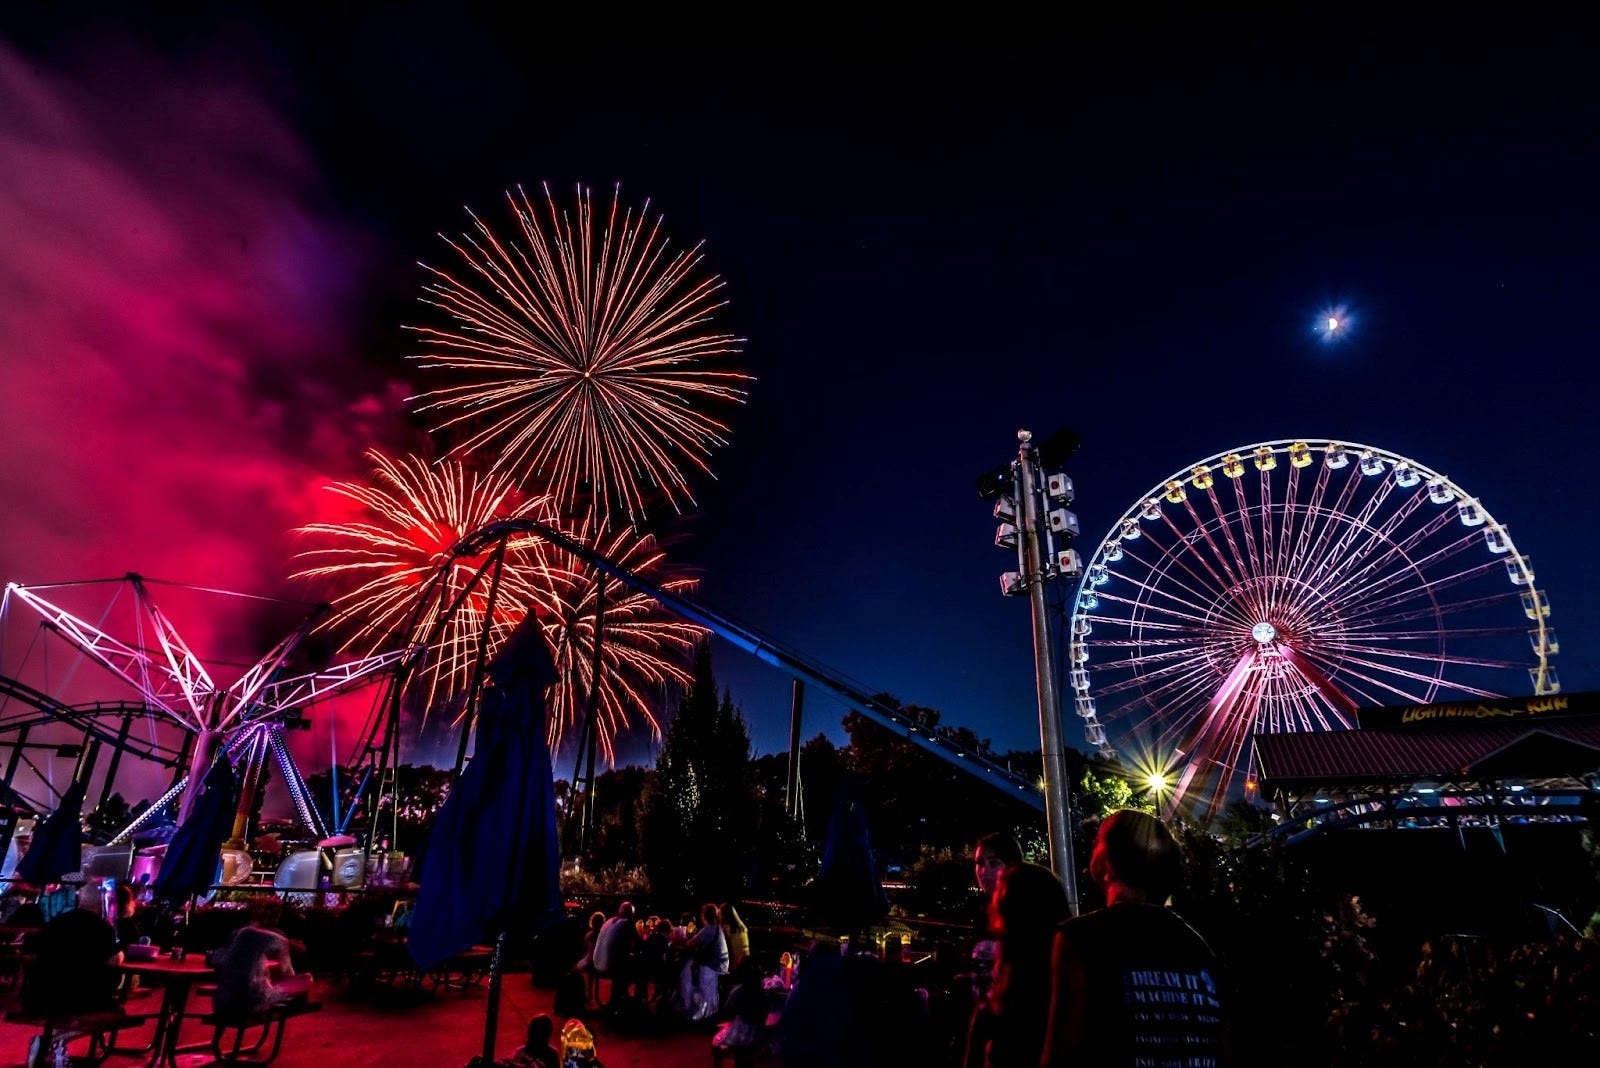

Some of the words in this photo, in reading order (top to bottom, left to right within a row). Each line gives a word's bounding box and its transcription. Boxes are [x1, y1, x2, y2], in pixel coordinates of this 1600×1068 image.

[1402, 704, 1490, 723] LIGHTNING
[1526, 697, 1569, 714] RUN
[1131, 970, 1181, 988] DREAM
[1185, 974, 1199, 990] IT
[1134, 991, 1188, 1004] MACHINE
[1192, 993, 1204, 1006] IT
